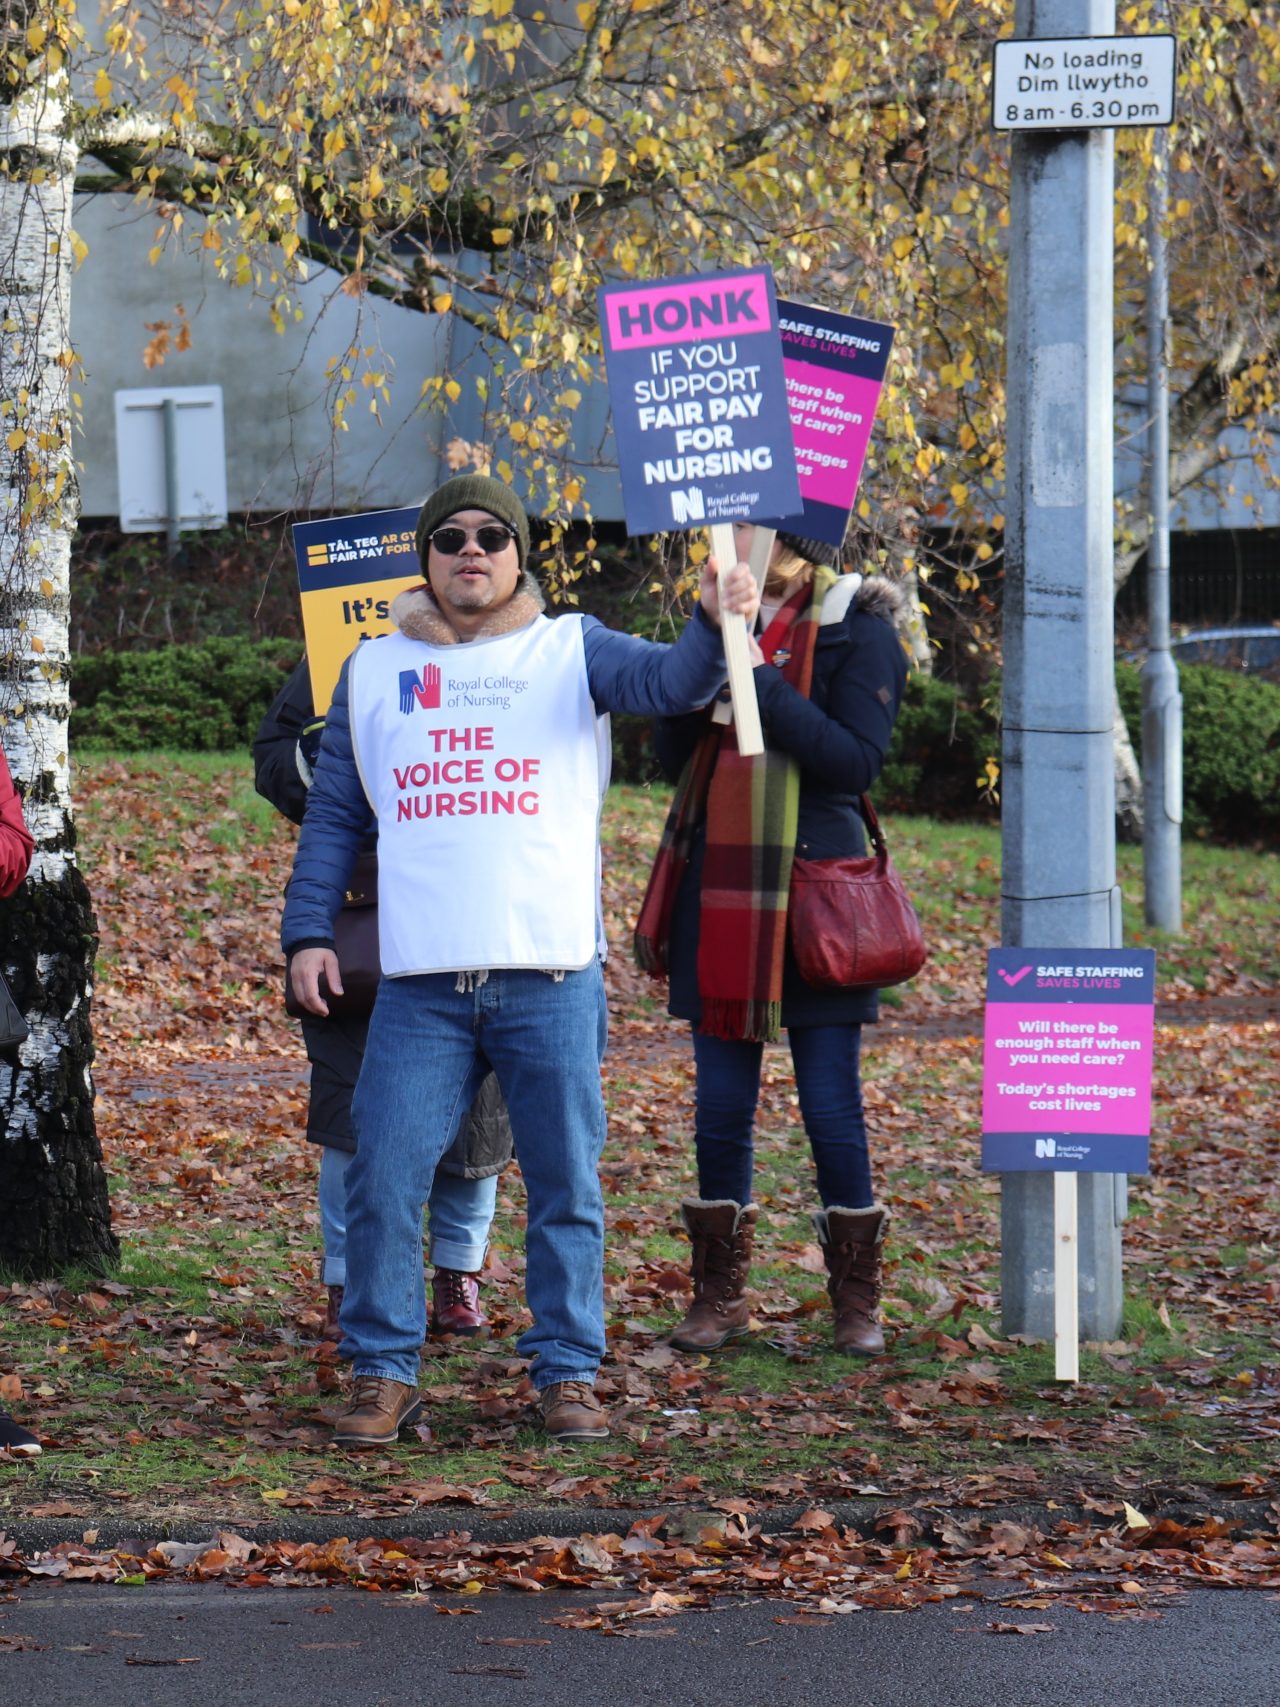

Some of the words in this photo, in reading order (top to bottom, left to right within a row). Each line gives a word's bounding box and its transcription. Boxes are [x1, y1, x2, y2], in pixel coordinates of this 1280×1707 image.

[1024, 53, 1054, 70] No
[1063, 50, 1142, 69] loading
[1018, 76, 1058, 92] Dim
[1068, 73, 1148, 92] llwytho
[618, 288, 758, 338] HONK
[778, 318, 814, 337] SAFE
[815, 328, 880, 353] STAFFING
[650, 350, 672, 374] IF
[679, 341, 737, 370] YOU
[820, 341, 856, 358] LIVES
[634, 366, 760, 404] SUPPORT
[825, 388, 844, 404] be
[638, 401, 704, 431] FAIR
[708, 392, 762, 422] PAY
[820, 404, 862, 424] when
[804, 417, 844, 435] care?
[676, 424, 734, 453] FOR
[644, 446, 772, 485] NURSING
[328, 539, 352, 553] TÂL
[354, 537, 378, 548] TEG
[381, 534, 399, 545] AR
[330, 551, 358, 564] FAIR
[360, 546, 384, 560] PAY
[386, 543, 410, 555] FOR
[342, 598, 390, 624] It’s
[448, 678, 480, 692] Royal
[484, 676, 528, 693] College
[447, 696, 462, 708] of
[463, 694, 510, 710] Nursing
[428, 726, 494, 752] THE
[392, 760, 484, 790] VOICE
[494, 758, 540, 782] OF
[398, 790, 540, 822] NURSING
[1037, 966, 1073, 978] SAFE
[1076, 967, 1144, 978] STAFFING
[1036, 978, 1080, 988] SAVES
[1084, 978, 1120, 989] LIVES
[1018, 1021, 1050, 1033] Will
[1053, 1022, 1096, 1034] there
[1098, 1022, 1118, 1034] be
[995, 1036, 1054, 1052] enough
[1056, 1036, 1094, 1049] staff
[1096, 1037, 1140, 1050] when
[1010, 1054, 1038, 1066] you
[1041, 1052, 1080, 1064] need
[1083, 1053, 1125, 1065] care?
[996, 1083, 1054, 1098] Today’s
[1057, 1084, 1136, 1098] shortages
[1028, 1099, 1062, 1111] cost
[1065, 1098, 1101, 1112] lives
